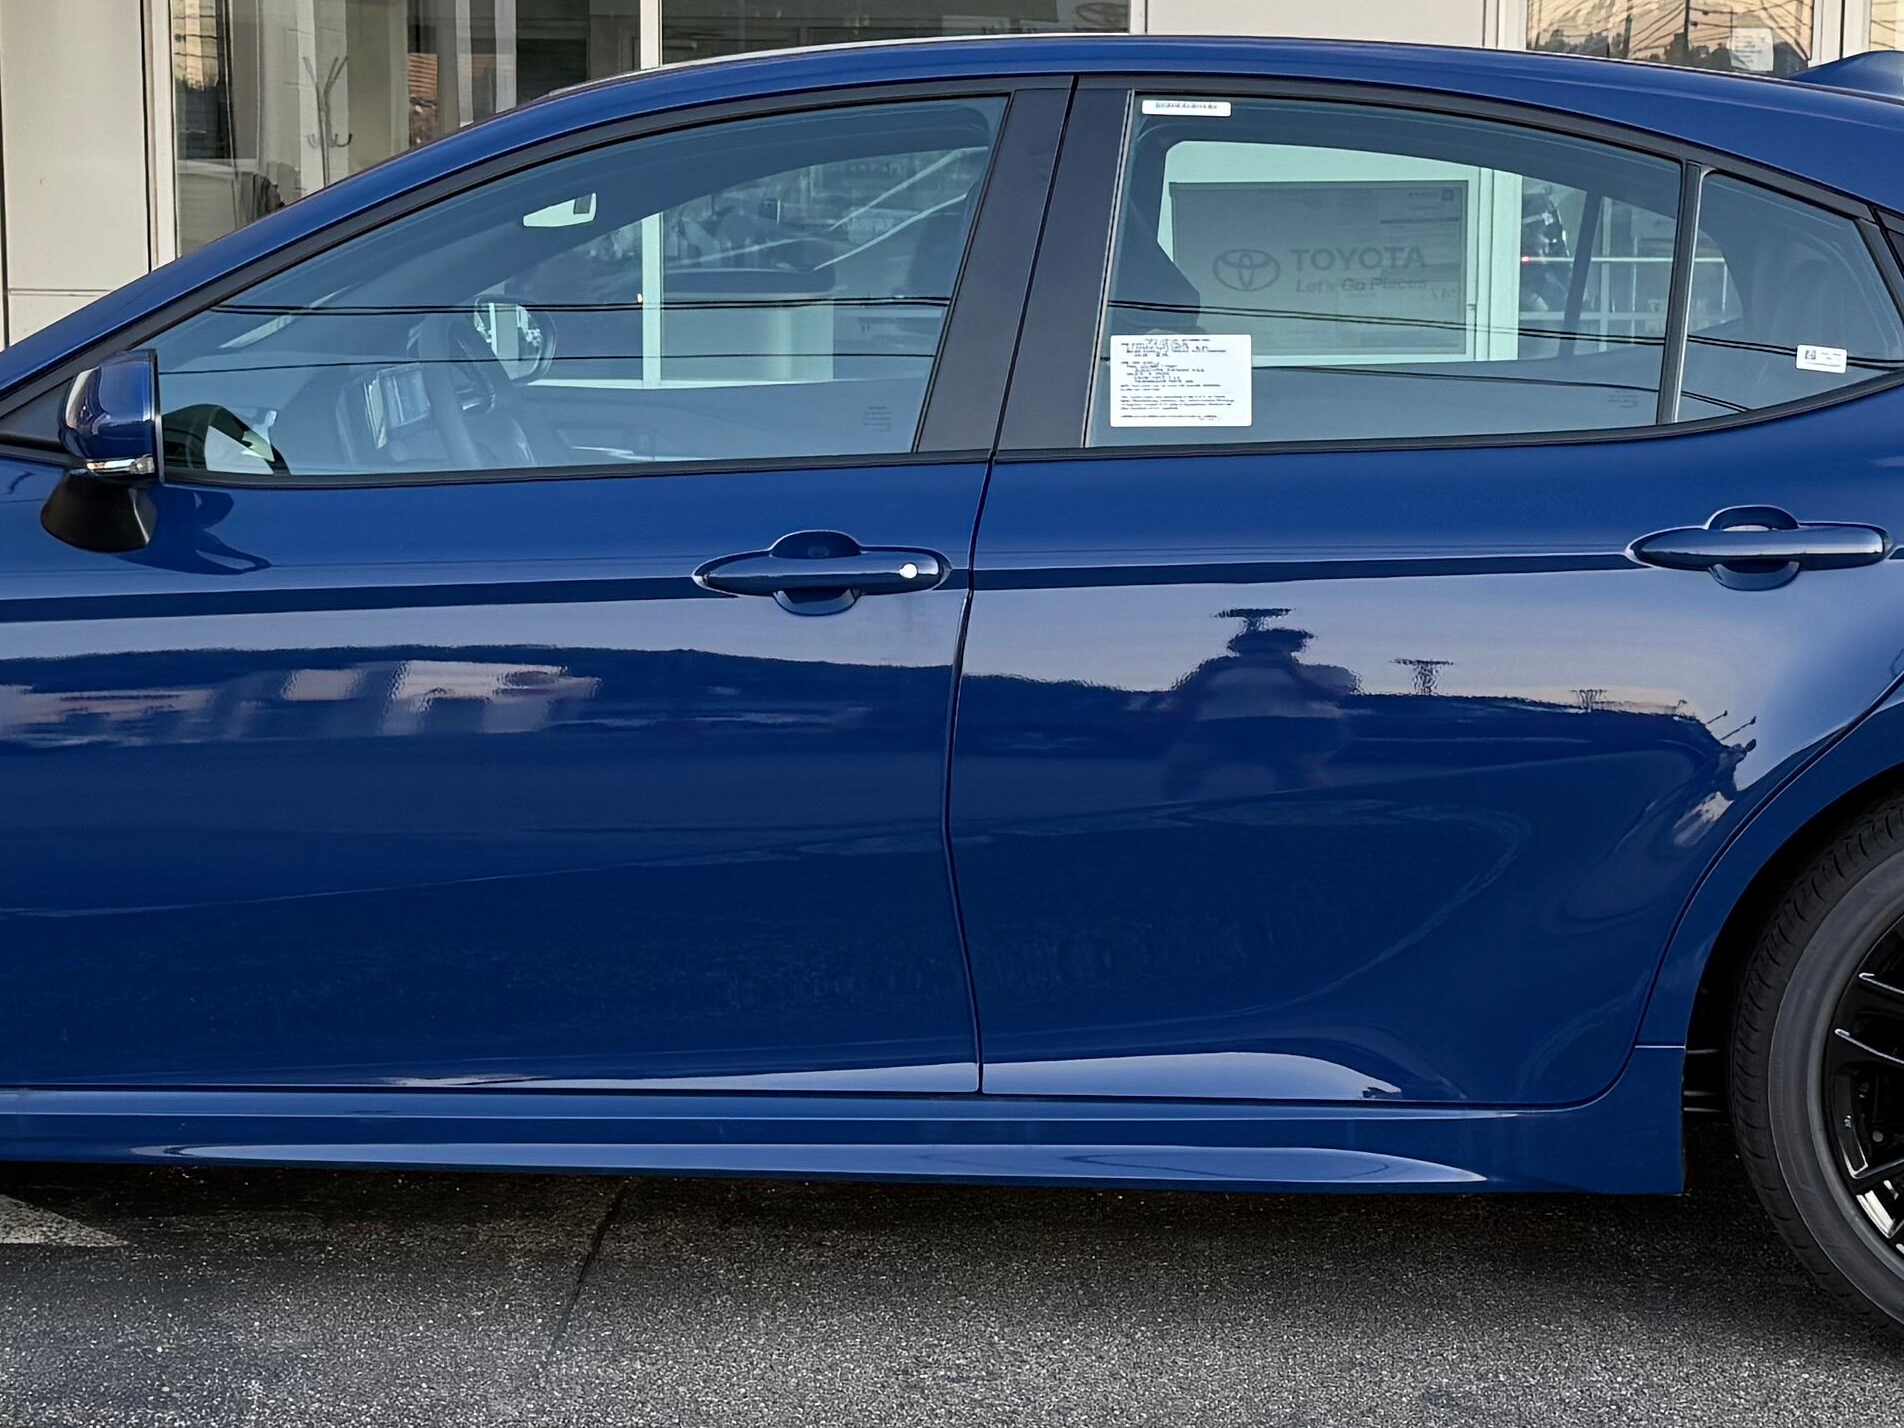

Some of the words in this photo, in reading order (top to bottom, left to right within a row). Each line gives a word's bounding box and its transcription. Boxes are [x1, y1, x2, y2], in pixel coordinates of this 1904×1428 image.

[1290, 247, 1427, 272] TOYOTA
[1297, 279, 1335, 293] Let's
[1342, 278, 1365, 292] Go
[1370, 277, 1426, 291] Places
